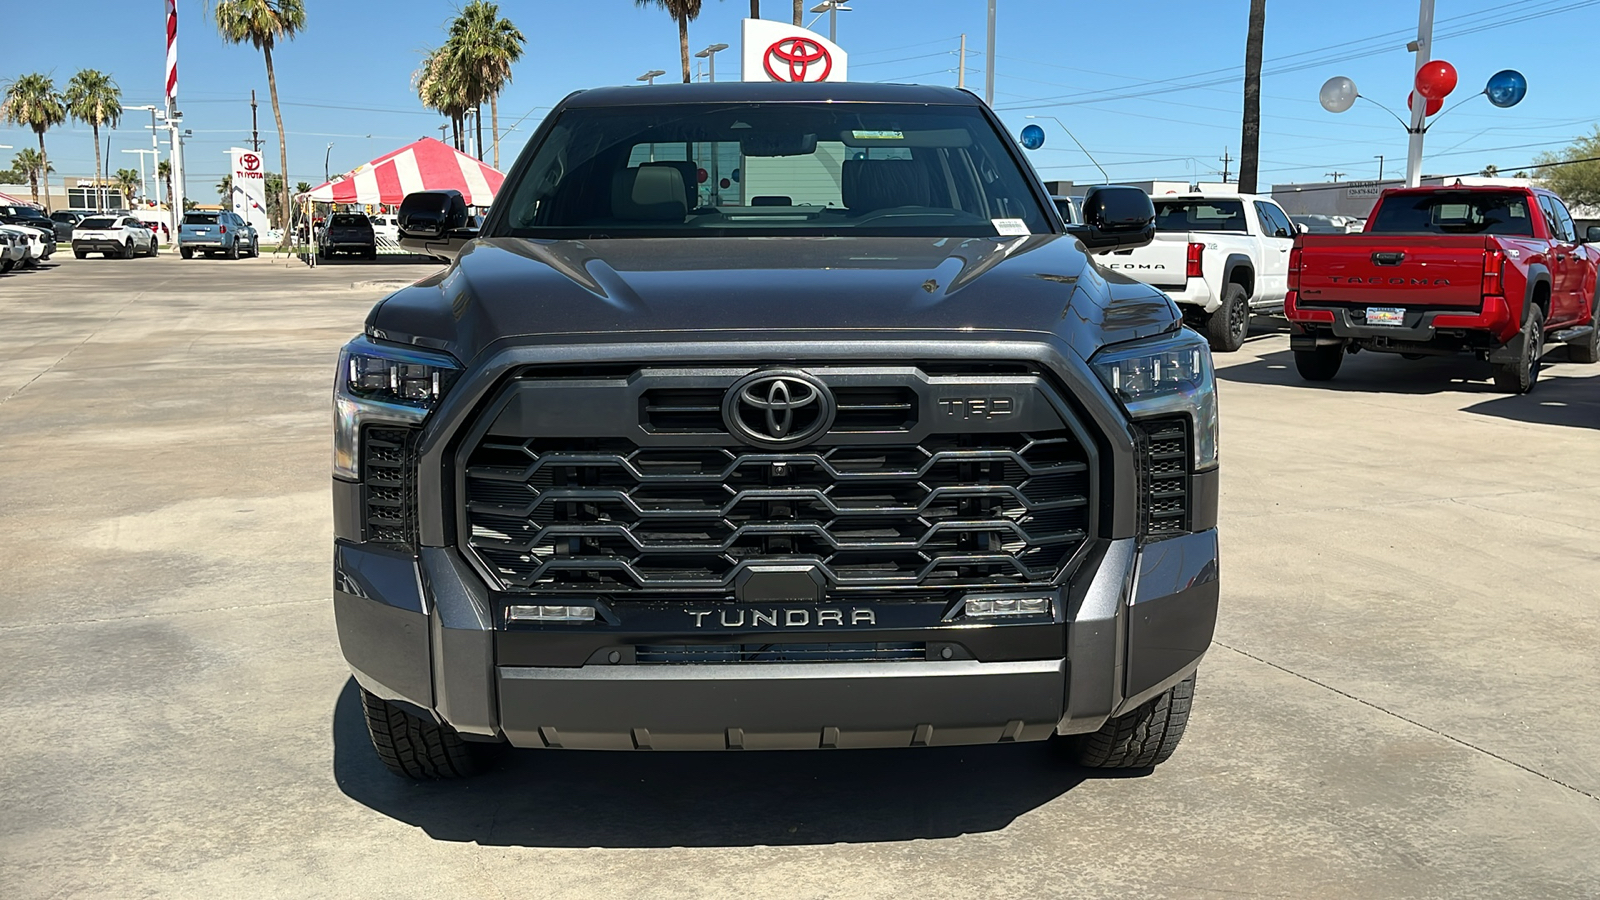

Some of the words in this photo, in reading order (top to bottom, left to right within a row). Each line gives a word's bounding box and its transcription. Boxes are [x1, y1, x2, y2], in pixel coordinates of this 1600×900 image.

[1097, 262, 1166, 270] COMA
[1328, 276, 1451, 286] TACOMA
[938, 397, 1013, 420] TRD
[684, 606, 876, 628] TUNDRA
